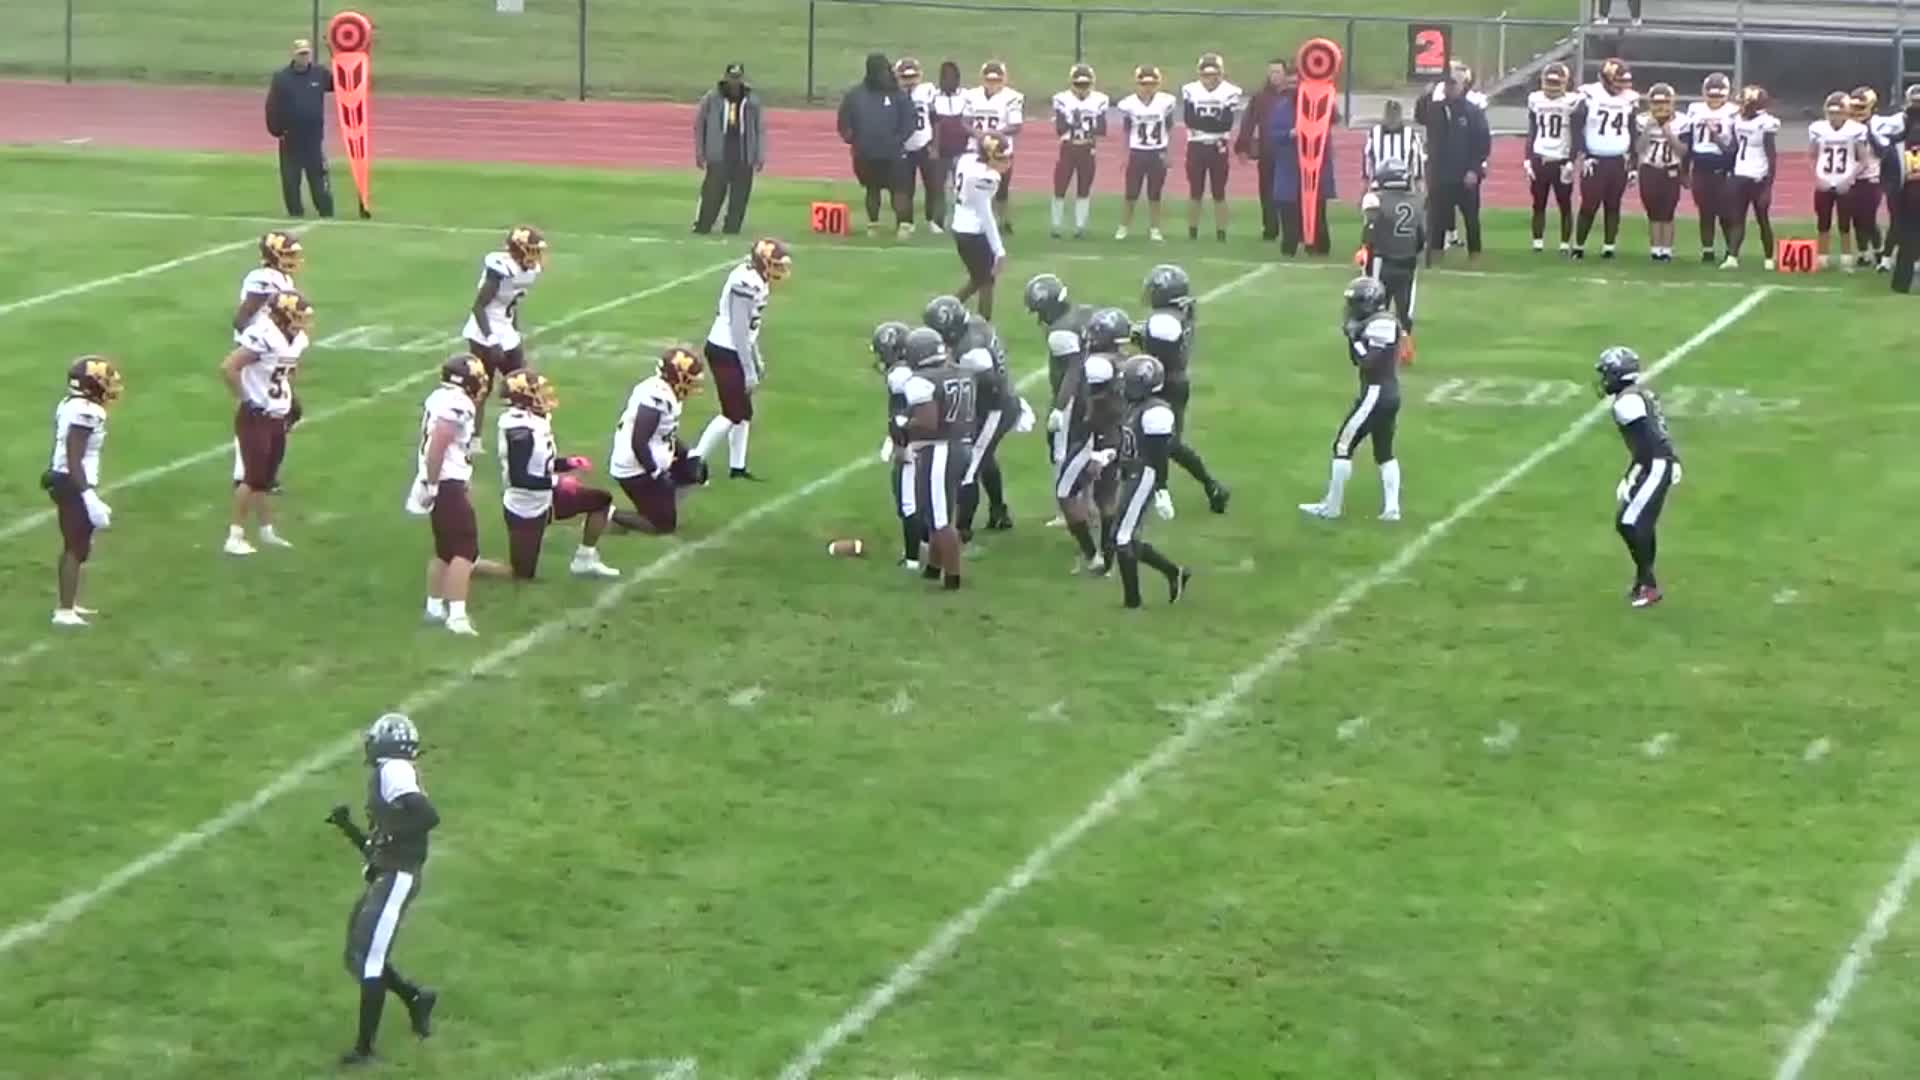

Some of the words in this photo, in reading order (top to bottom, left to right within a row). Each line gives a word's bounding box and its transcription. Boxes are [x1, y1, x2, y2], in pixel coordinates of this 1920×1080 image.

[1415, 29, 1444, 66] 2
[1137, 121, 1162, 145] 44
[1537, 113, 1562, 138] 10
[1597, 110, 1623, 136] 74
[1823, 147, 1848, 174] 33
[814, 205, 842, 233] 30
[1394, 202, 1415, 237] 2
[1782, 243, 1812, 272] 40
